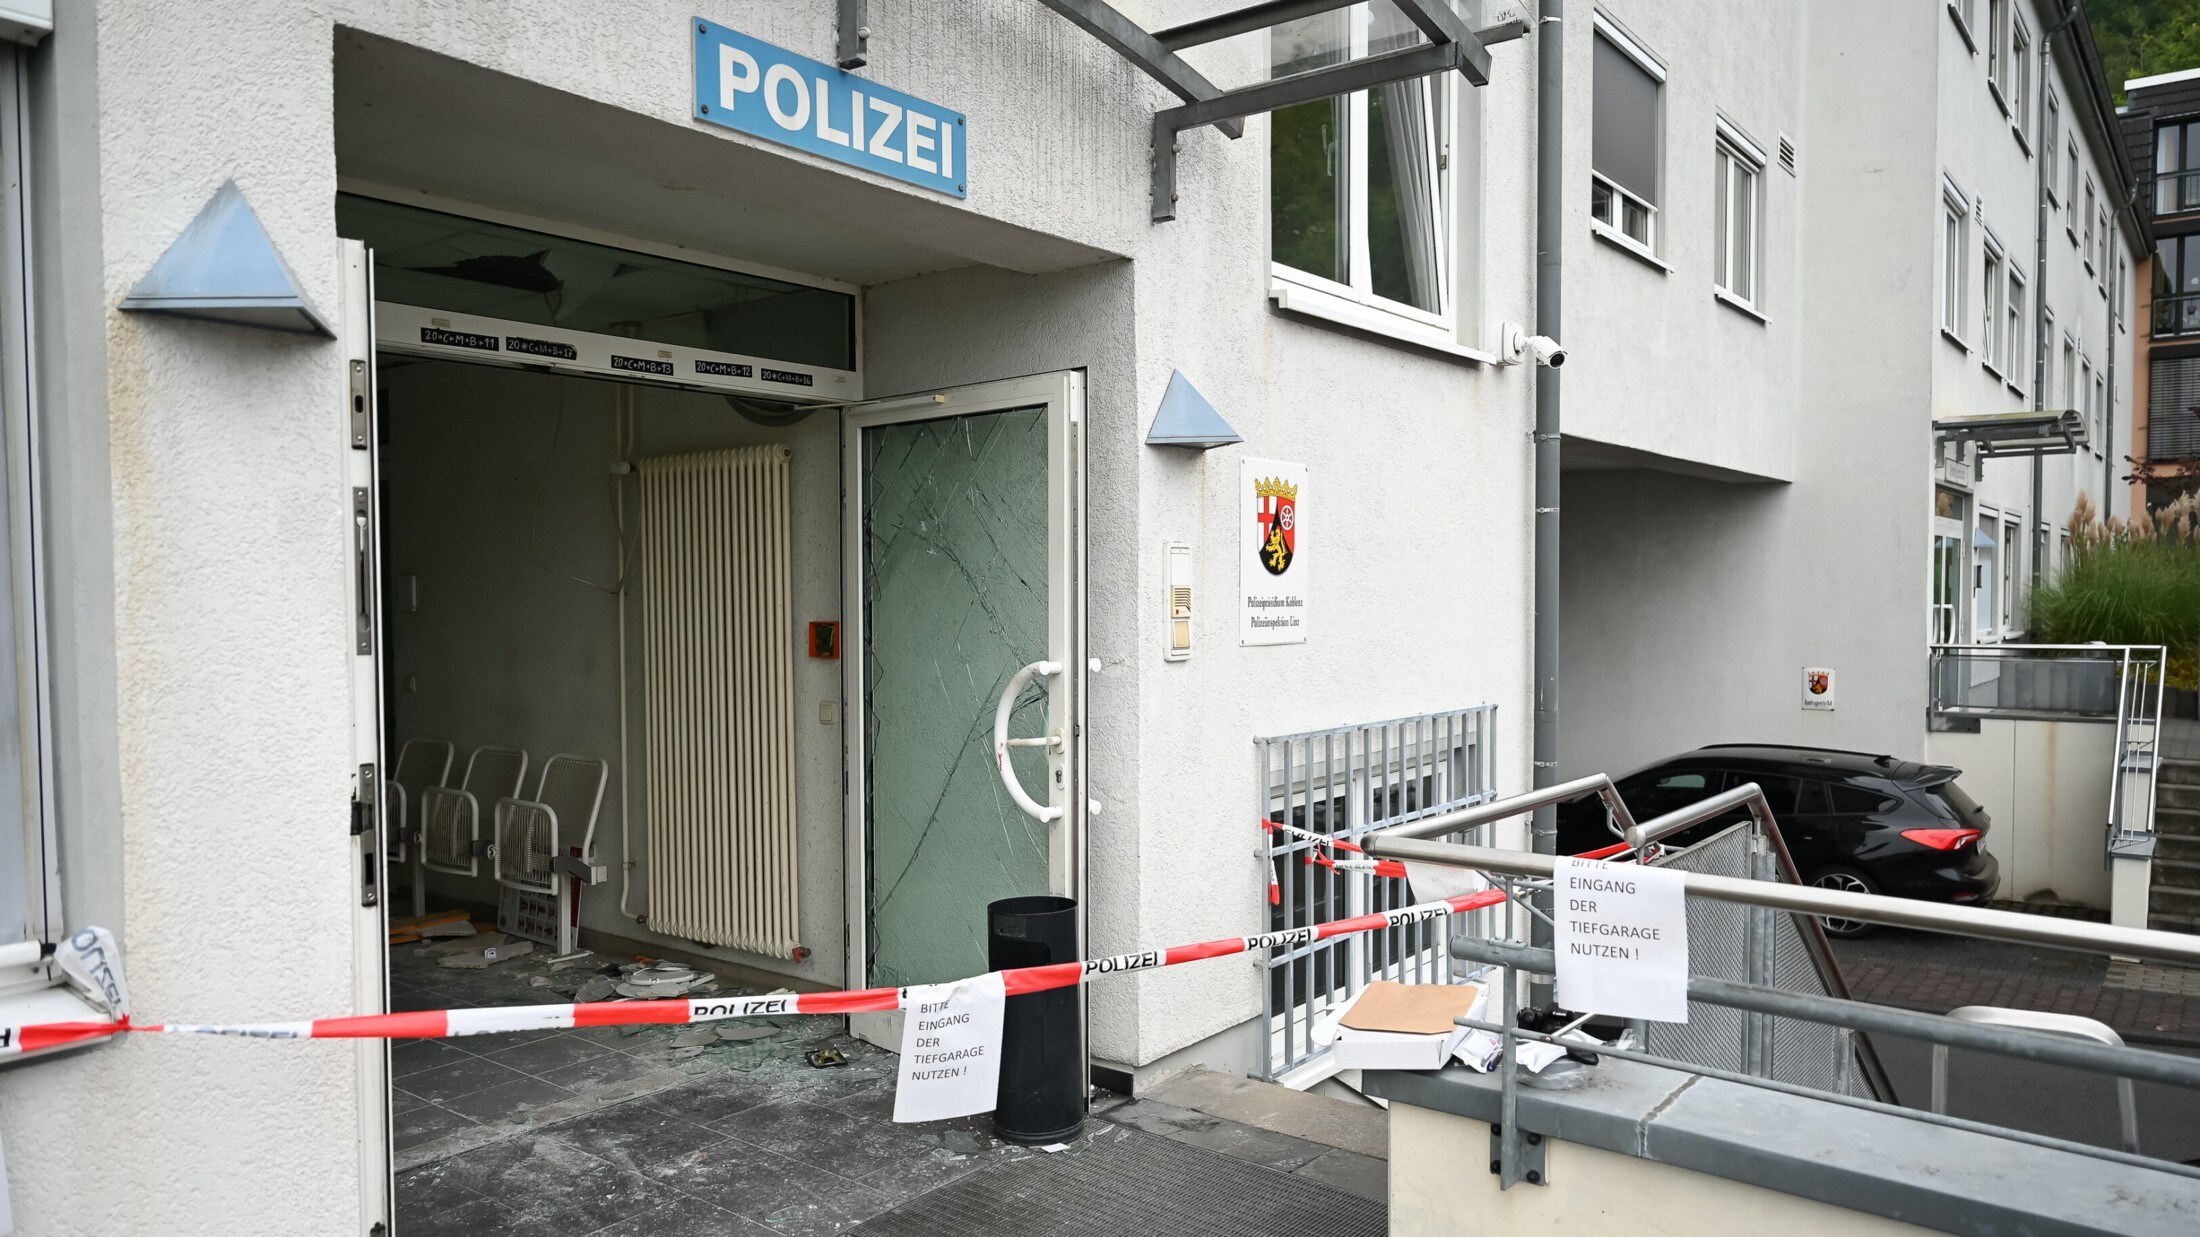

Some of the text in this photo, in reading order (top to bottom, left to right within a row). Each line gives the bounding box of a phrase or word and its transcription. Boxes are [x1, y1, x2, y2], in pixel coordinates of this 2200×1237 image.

[719, 43, 953, 179] POLIZEI
[1570, 877, 1636, 895] EINGANG
[1570, 899, 1598, 913] DER
[1247, 928, 1311, 951] POLIZEI
[1570, 921, 1660, 941] TIEFGARAGE
[1571, 943, 1629, 960] NUTZEN
[1085, 950, 1158, 976] POLIZEI
[920, 1000, 950, 1014] BITTE
[918, 1013, 970, 1031] EINGANG
[916, 1038, 940, 1048] DER
[914, 1046, 984, 1064] TIEFGARAGE
[912, 1068, 960, 1081] NUTZEN
